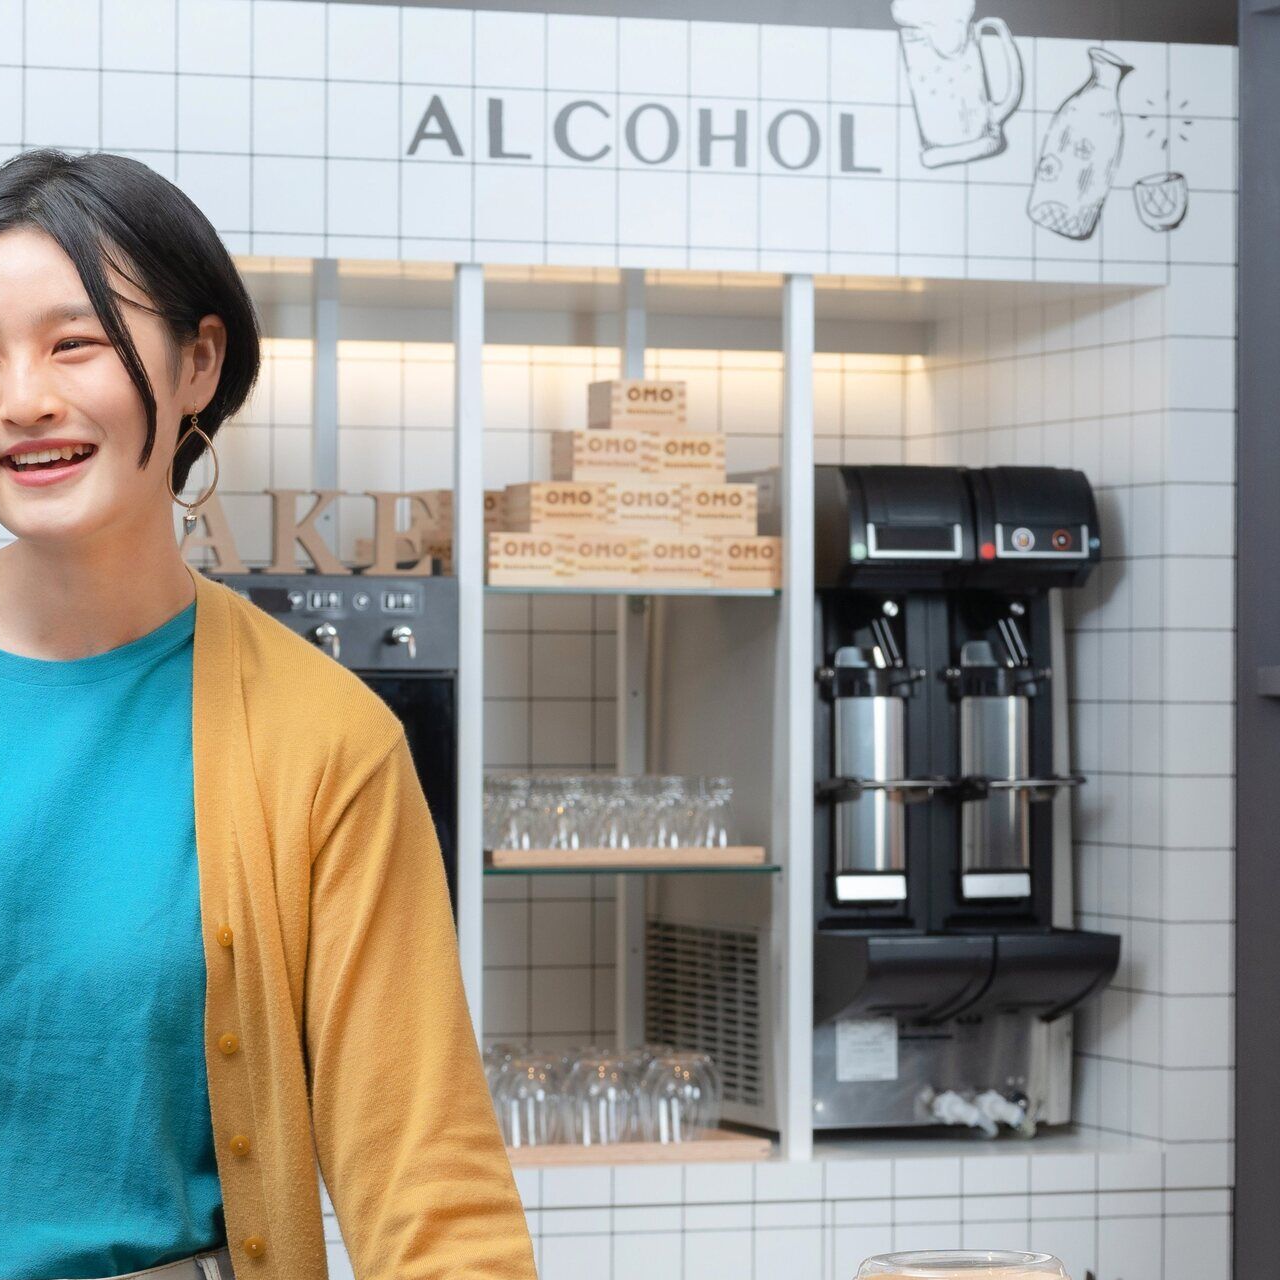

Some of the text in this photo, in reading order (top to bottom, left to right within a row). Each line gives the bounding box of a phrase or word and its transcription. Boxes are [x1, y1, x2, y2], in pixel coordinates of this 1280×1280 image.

[406, 94, 882, 174] ALCOHOL
[628, 386, 674, 402] OMO
[588, 438, 637, 454] OMO
[665, 440, 711, 456] OMO
[546, 490, 592, 506] OMO
[622, 491, 669, 507] OMO
[697, 492, 742, 507] OMO
[504, 541, 553, 557] OMO
[579, 541, 627, 558] OMO
[654, 543, 701, 560] OMO
[729, 543, 774, 560] OMO
